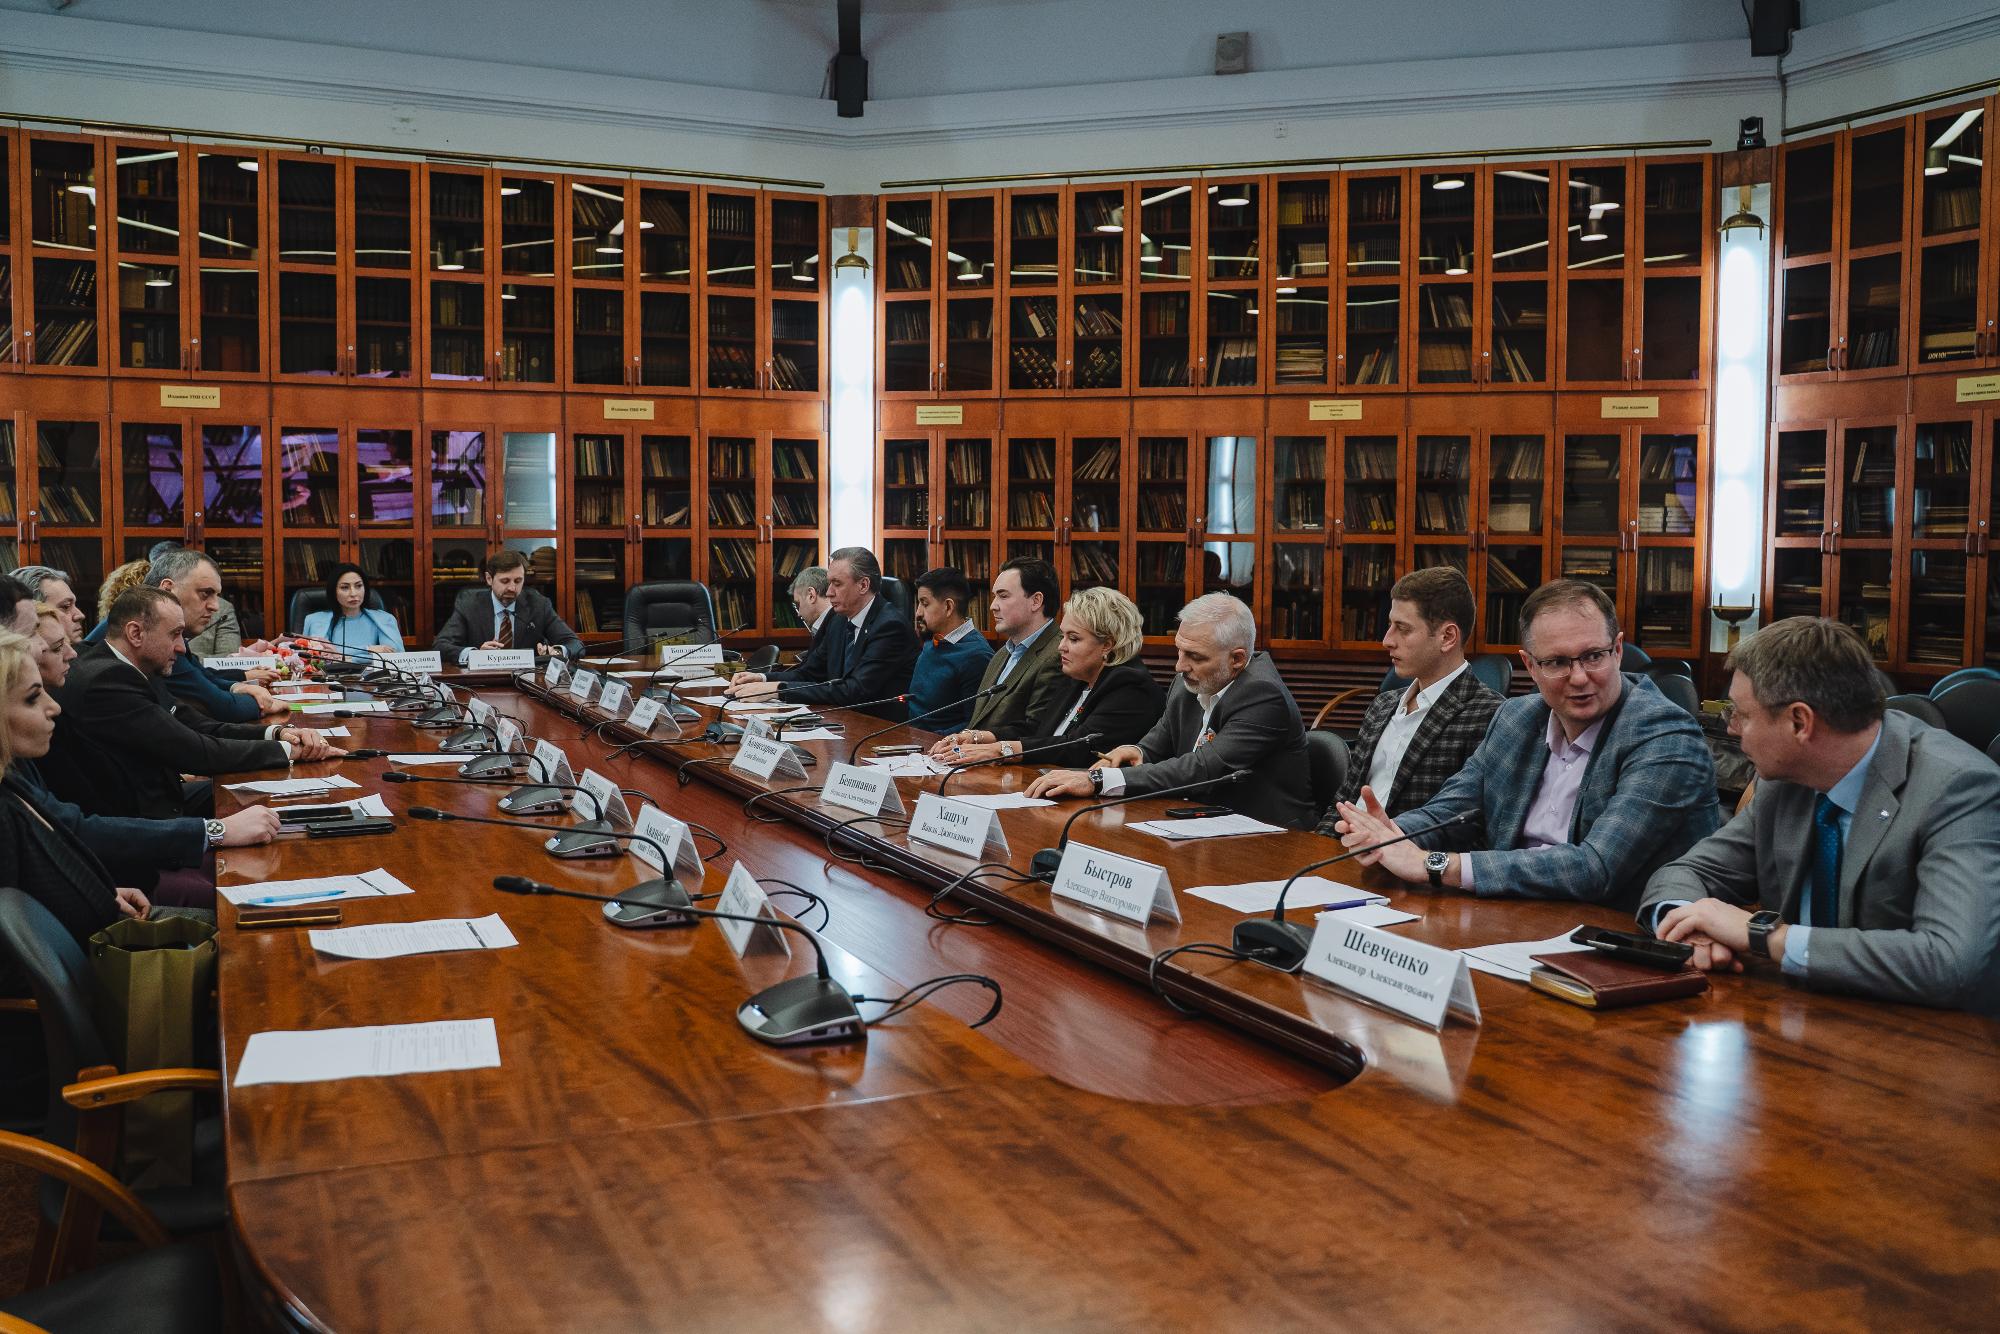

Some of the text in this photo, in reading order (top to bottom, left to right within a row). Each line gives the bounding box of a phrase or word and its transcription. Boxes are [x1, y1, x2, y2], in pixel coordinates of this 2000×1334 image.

[487, 654, 521, 662] Куракин
[1084, 859, 1133, 889] Быстров
[1064, 878, 1142, 915] Александр Викторович
[1325, 952, 1367, 977] Александр
[1343, 928, 1429, 976] Шевченко
